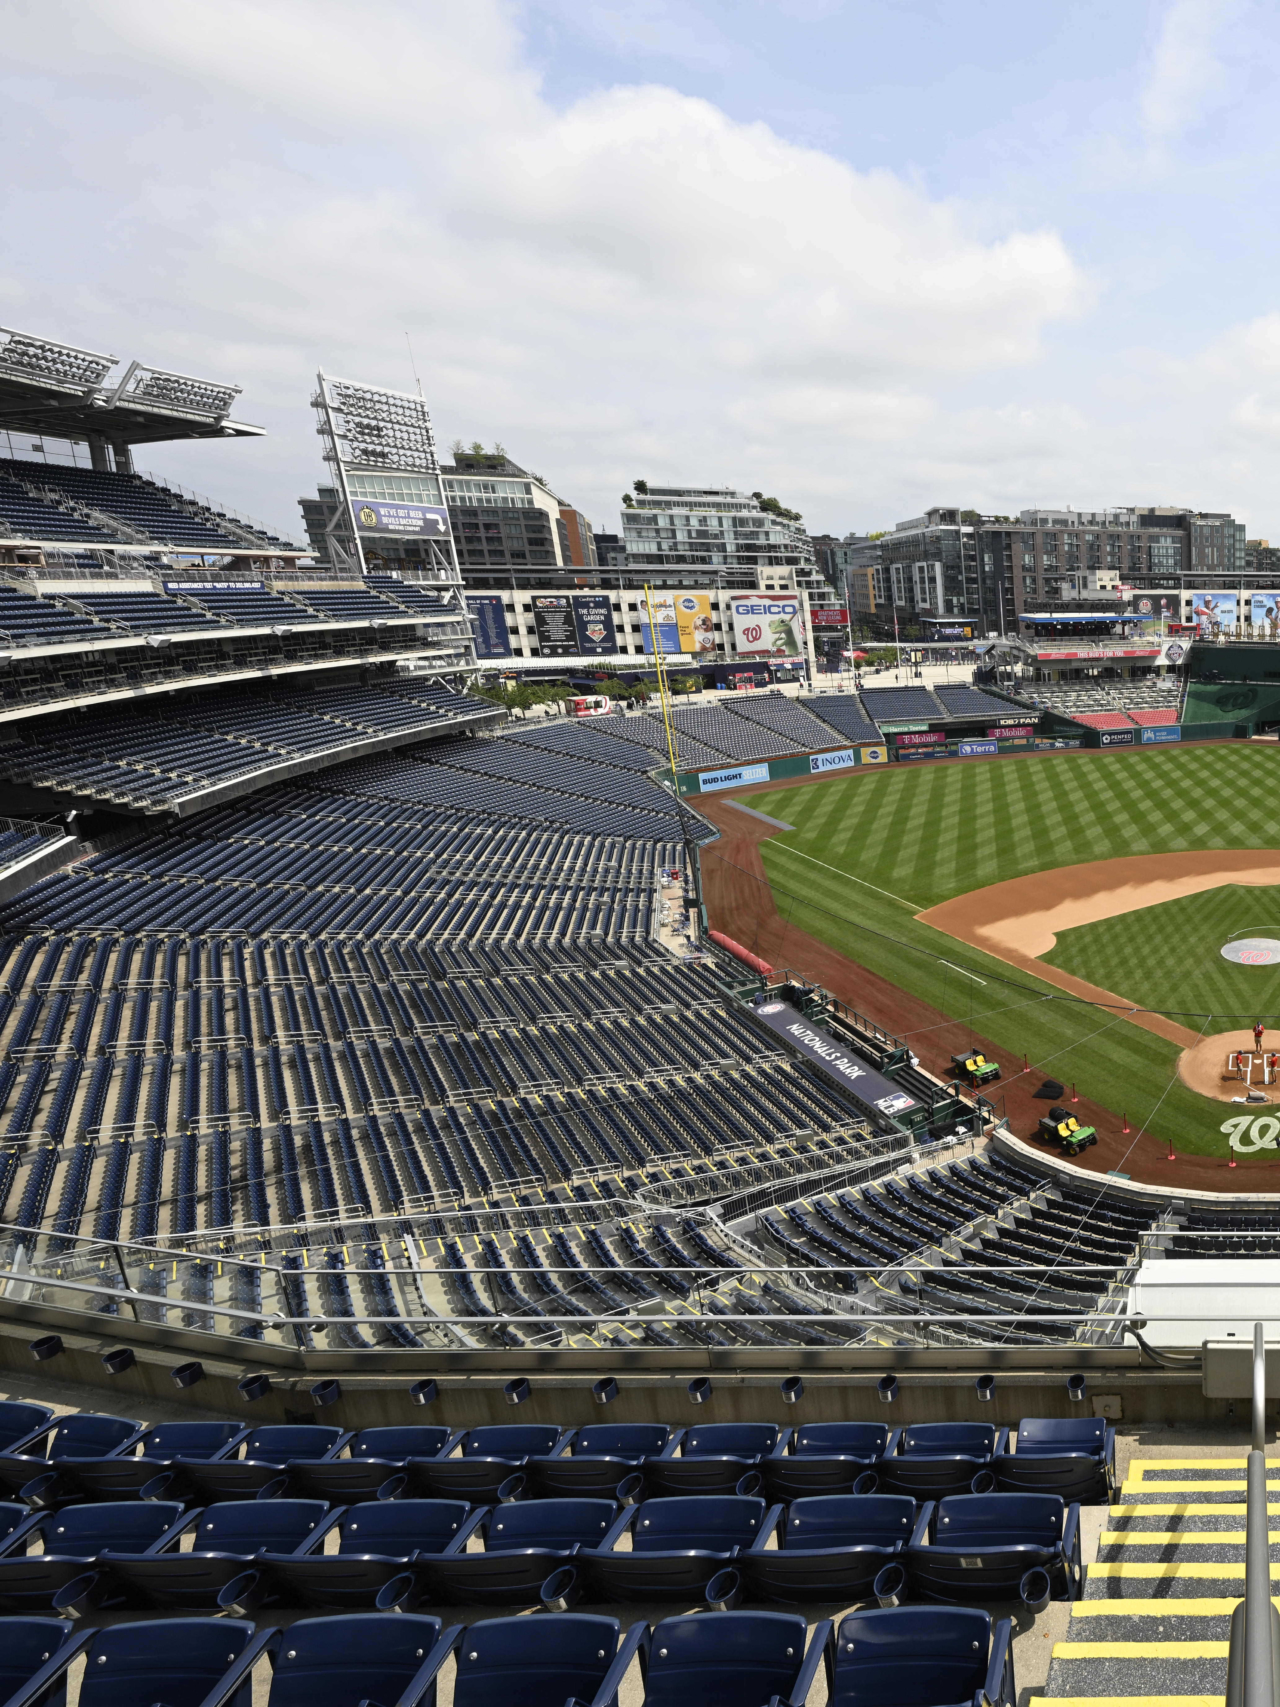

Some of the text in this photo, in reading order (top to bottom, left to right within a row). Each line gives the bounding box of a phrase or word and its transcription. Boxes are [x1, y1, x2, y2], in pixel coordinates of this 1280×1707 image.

[736, 604, 796, 615] GEICO
[742, 624, 762, 643] W
[912, 734, 938, 743] Mobile
[1002, 728, 1026, 736] Mobile
[822, 754, 852, 766] INOVA
[702, 768, 766, 785] BUD LIGHT SELTZER
[786, 1022, 866, 1080] NATIONALS PARK
[873, 1097, 898, 1115] MLB
